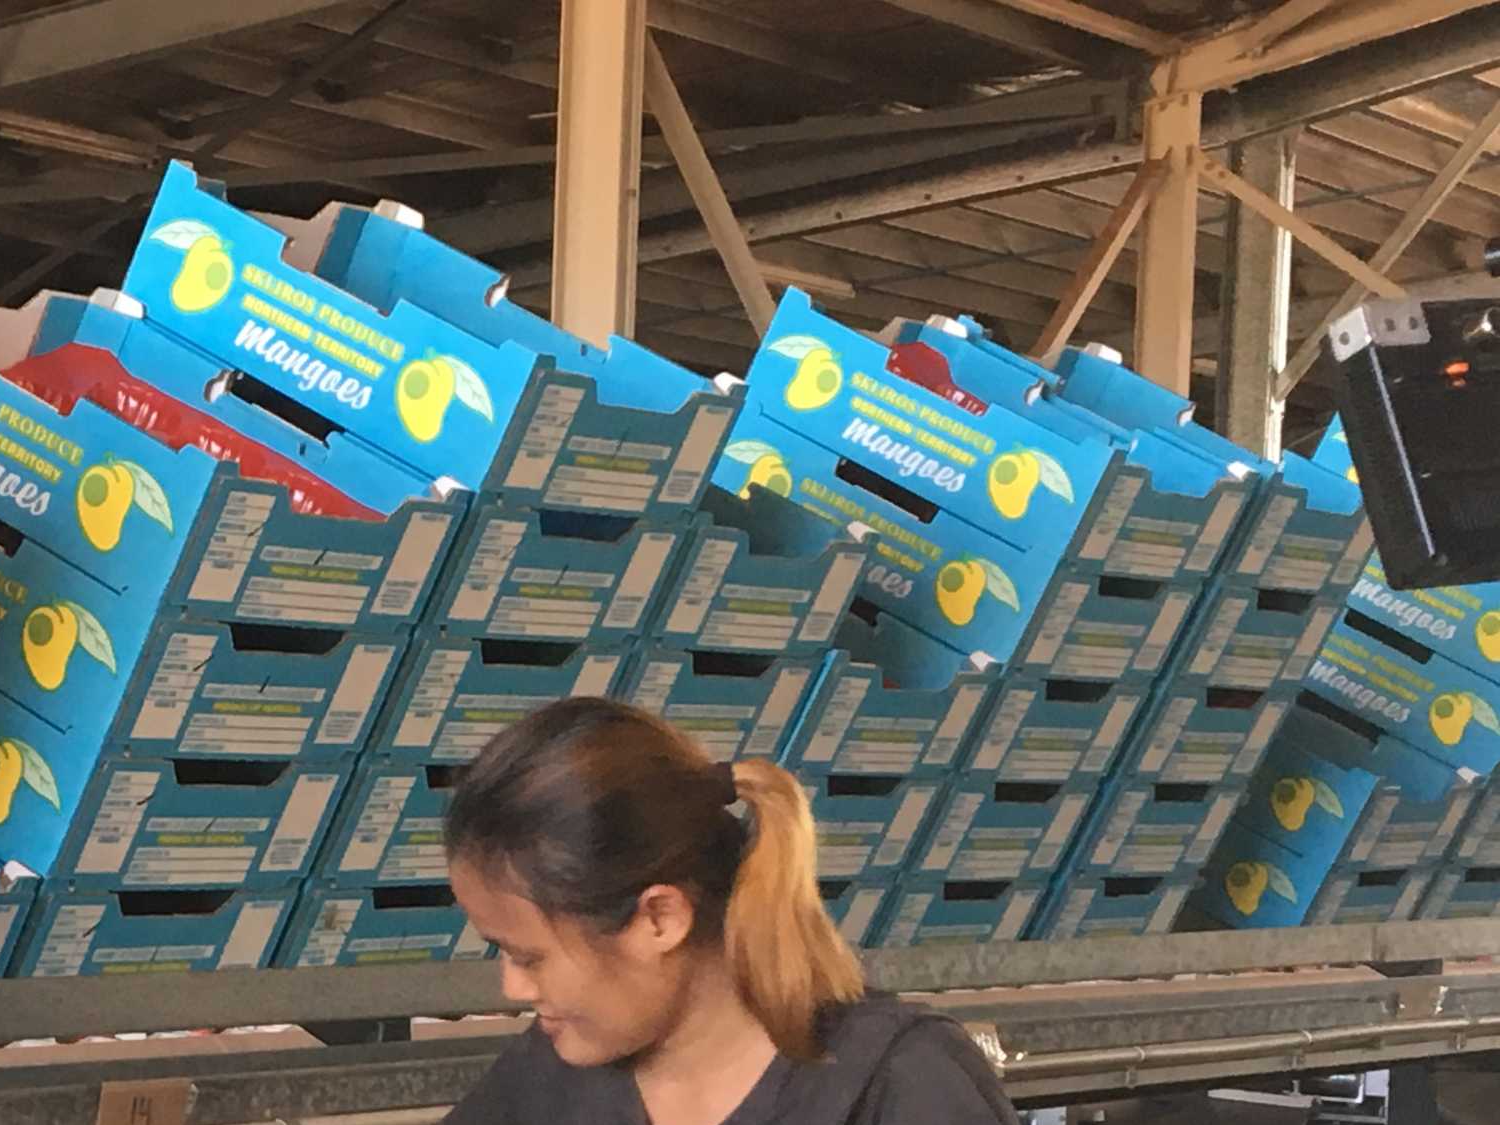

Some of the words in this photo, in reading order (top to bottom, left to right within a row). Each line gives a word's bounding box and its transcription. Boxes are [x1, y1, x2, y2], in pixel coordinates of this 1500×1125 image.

[234, 320, 372, 409] Mangoes
[241, 293, 312, 342] NORTHERN
[312, 331, 385, 381] TERRITORY
[841, 417, 966, 492] Mangoes
